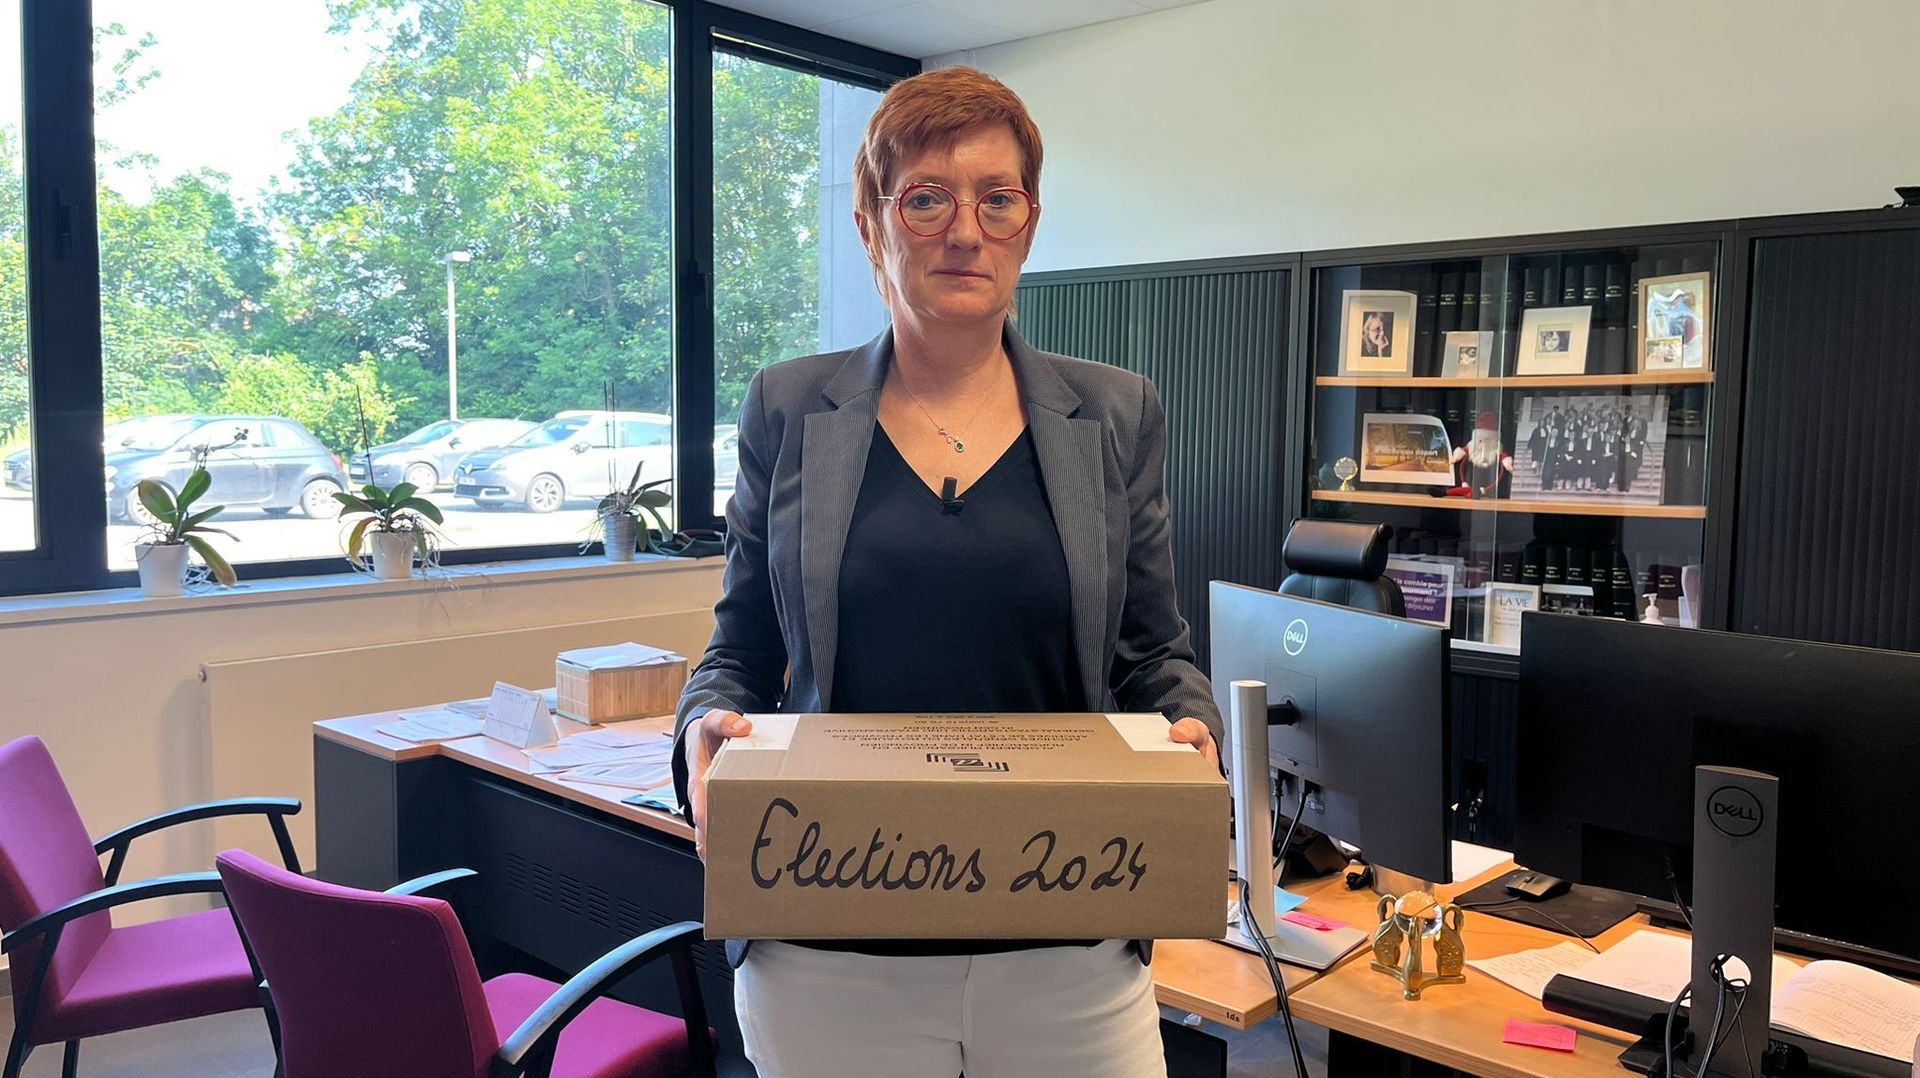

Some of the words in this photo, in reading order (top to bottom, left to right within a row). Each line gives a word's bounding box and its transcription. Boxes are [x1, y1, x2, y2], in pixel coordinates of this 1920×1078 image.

[1287, 631, 1303, 644] DELL
[1714, 802, 1757, 821] DELL
[751, 798, 986, 893] Elections
[1010, 830, 1147, 892] 2024
